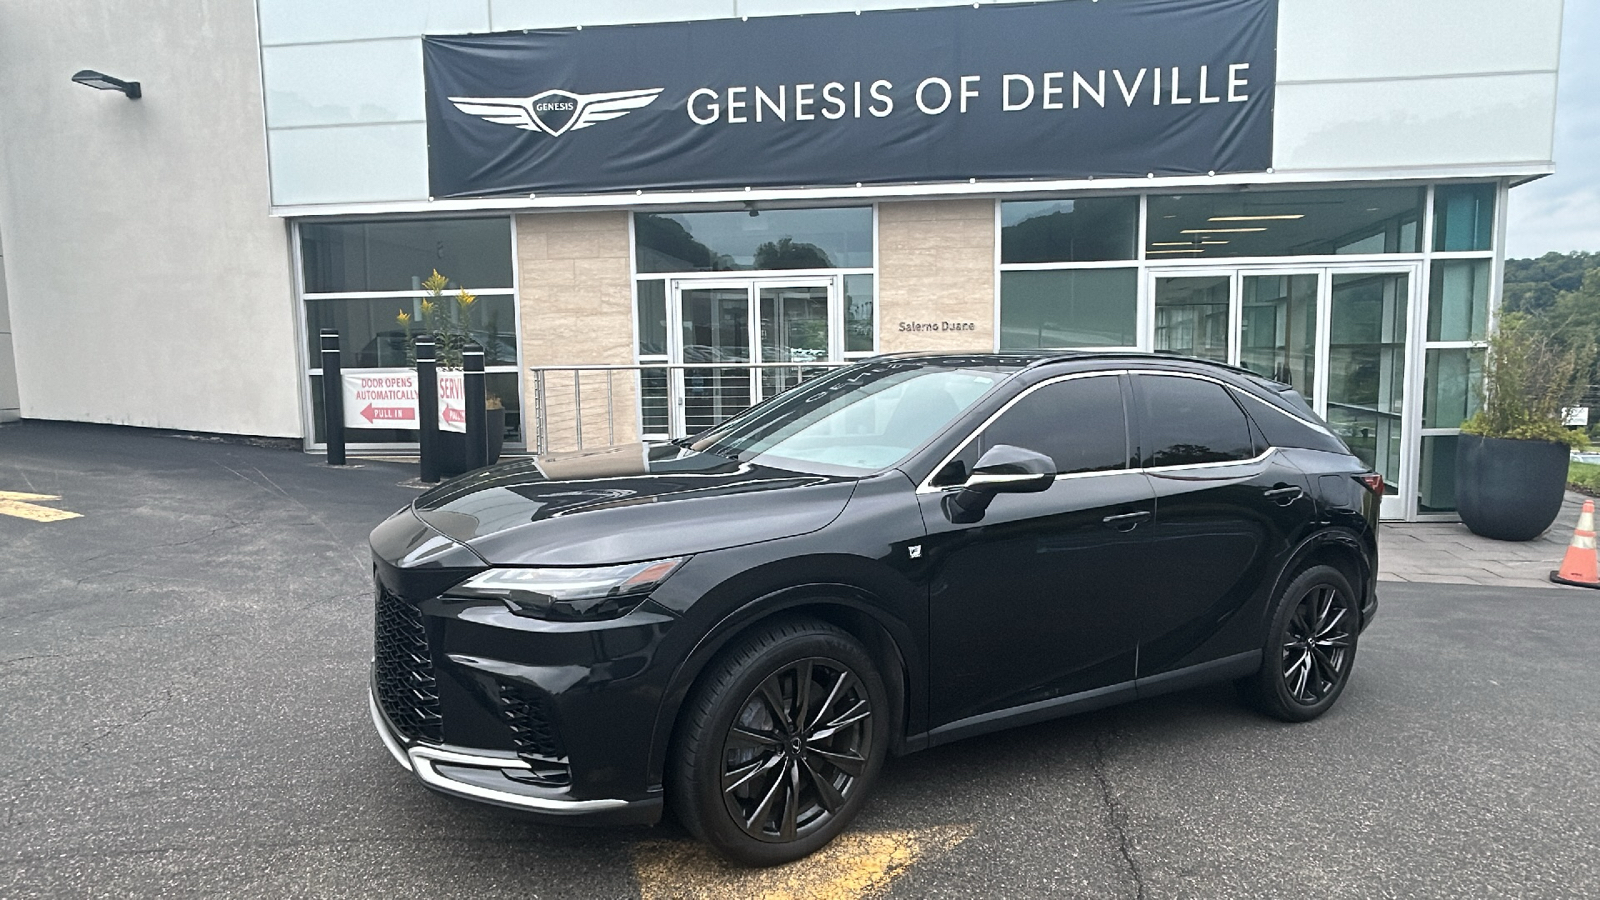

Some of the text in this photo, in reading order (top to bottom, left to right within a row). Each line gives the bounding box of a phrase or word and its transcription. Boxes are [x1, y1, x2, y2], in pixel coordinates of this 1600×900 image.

[687, 63, 1250, 126] GENESIS OF DENVILLE
[536, 102, 574, 111] GENESIS
[899, 321, 975, 332] Salerno Duane
[361, 377, 412, 388] DOOR OPENS
[439, 377, 465, 400] SERVI
[356, 389, 419, 400] AUTOMATICALLY
[374, 408, 403, 418] PULL IN
